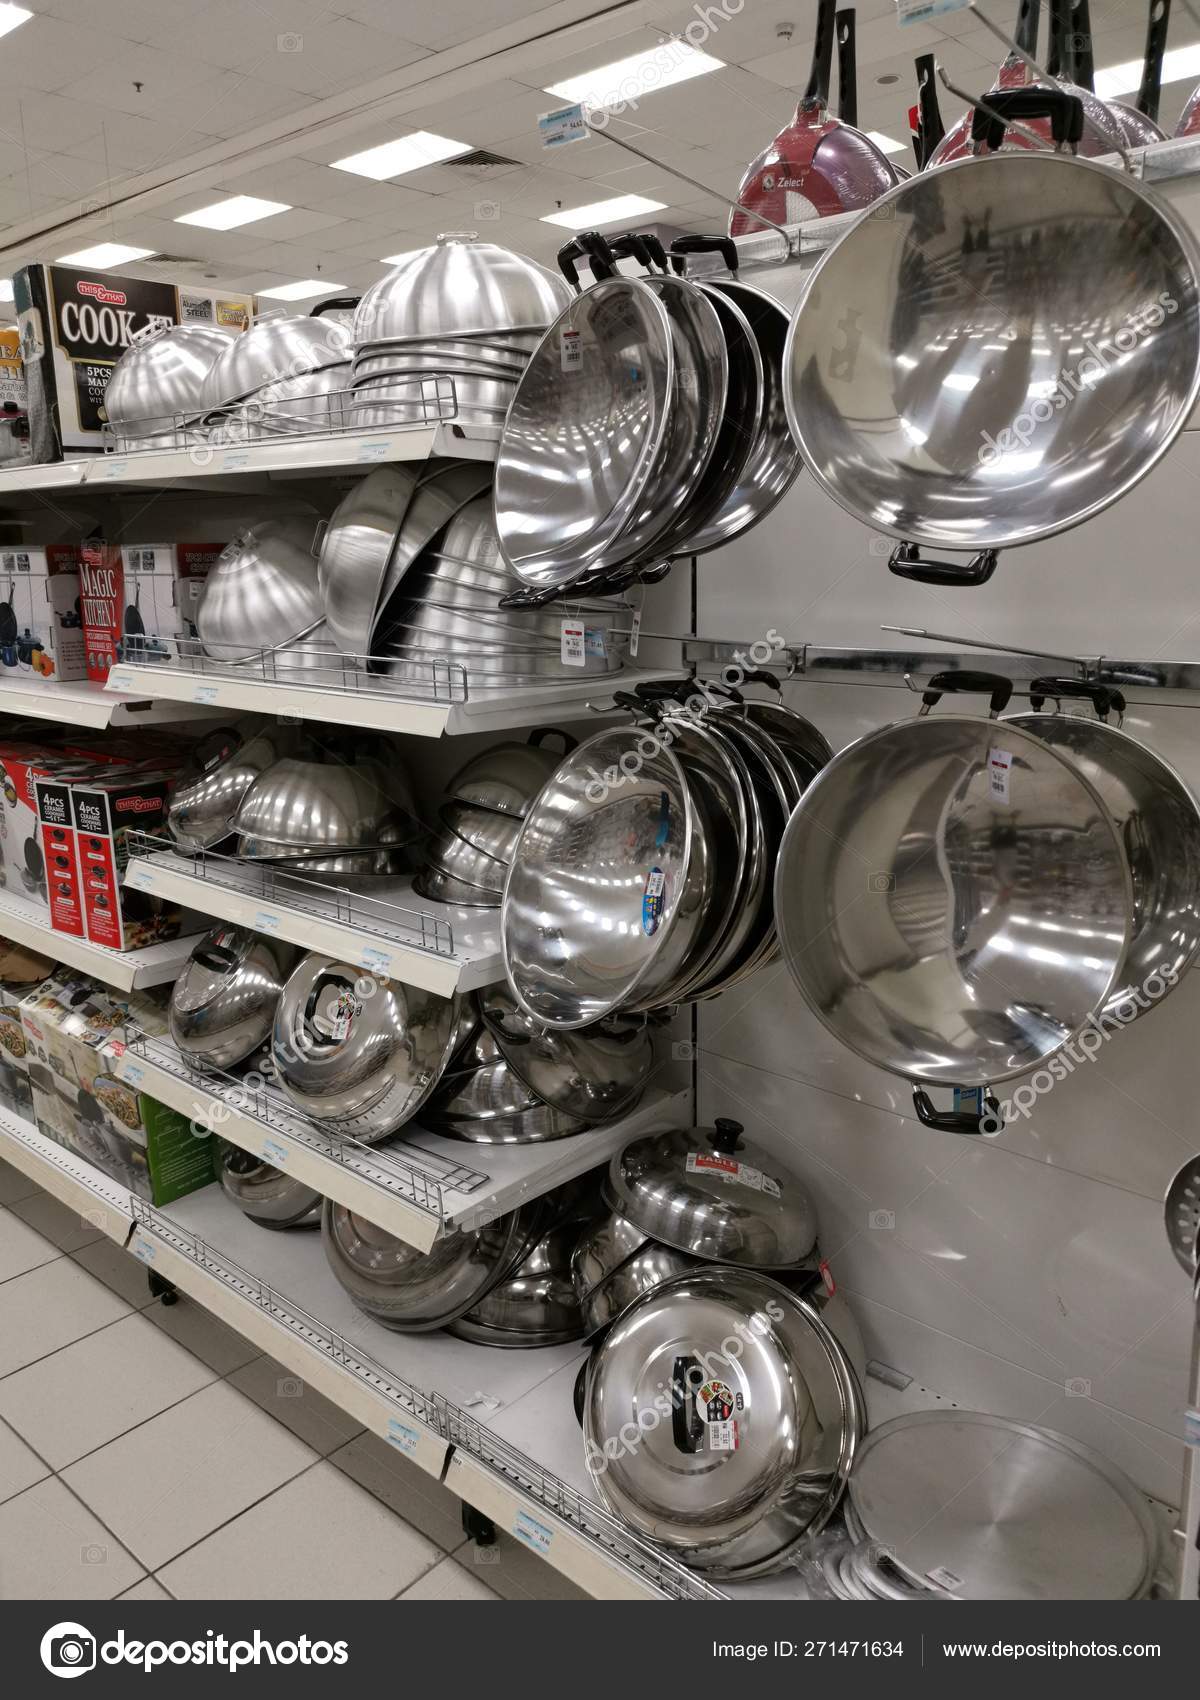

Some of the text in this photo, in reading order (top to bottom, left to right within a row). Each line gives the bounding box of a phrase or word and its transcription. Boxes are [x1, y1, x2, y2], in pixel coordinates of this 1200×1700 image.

[777, 176, 804, 188] Zelect
[186, 308, 209, 318] STEEL
[61, 301, 136, 347] COOK
[80, 564, 117, 597] MAGIC
[83, 599, 111, 627] KITCHEN
[44, 793, 64, 807] 4PCS
[79, 801, 100, 815] 4PCS
